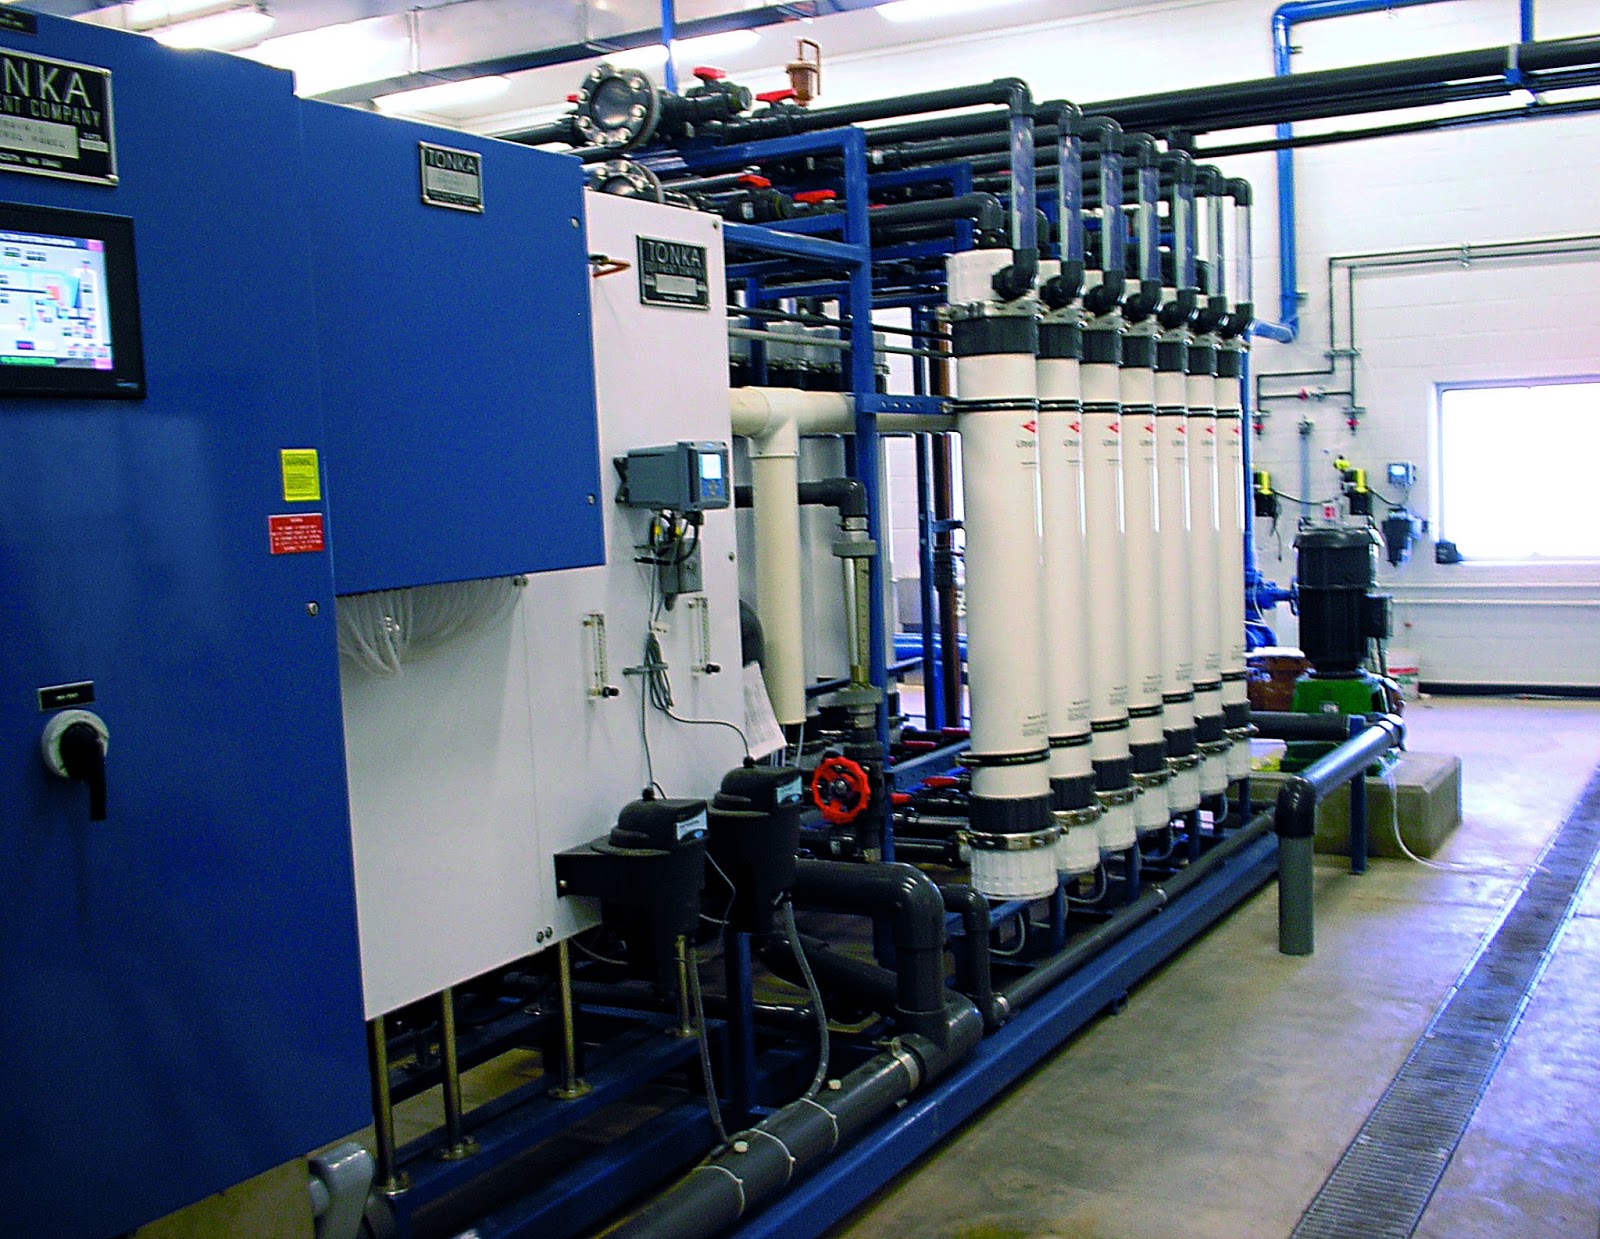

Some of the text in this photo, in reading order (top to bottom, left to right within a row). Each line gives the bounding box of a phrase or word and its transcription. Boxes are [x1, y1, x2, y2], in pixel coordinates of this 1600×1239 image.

[3, 57, 92, 108] NKA
[0, 94, 102, 127] NT COMPANY
[427, 149, 478, 175] TONKA
[646, 241, 702, 268] TONKA
